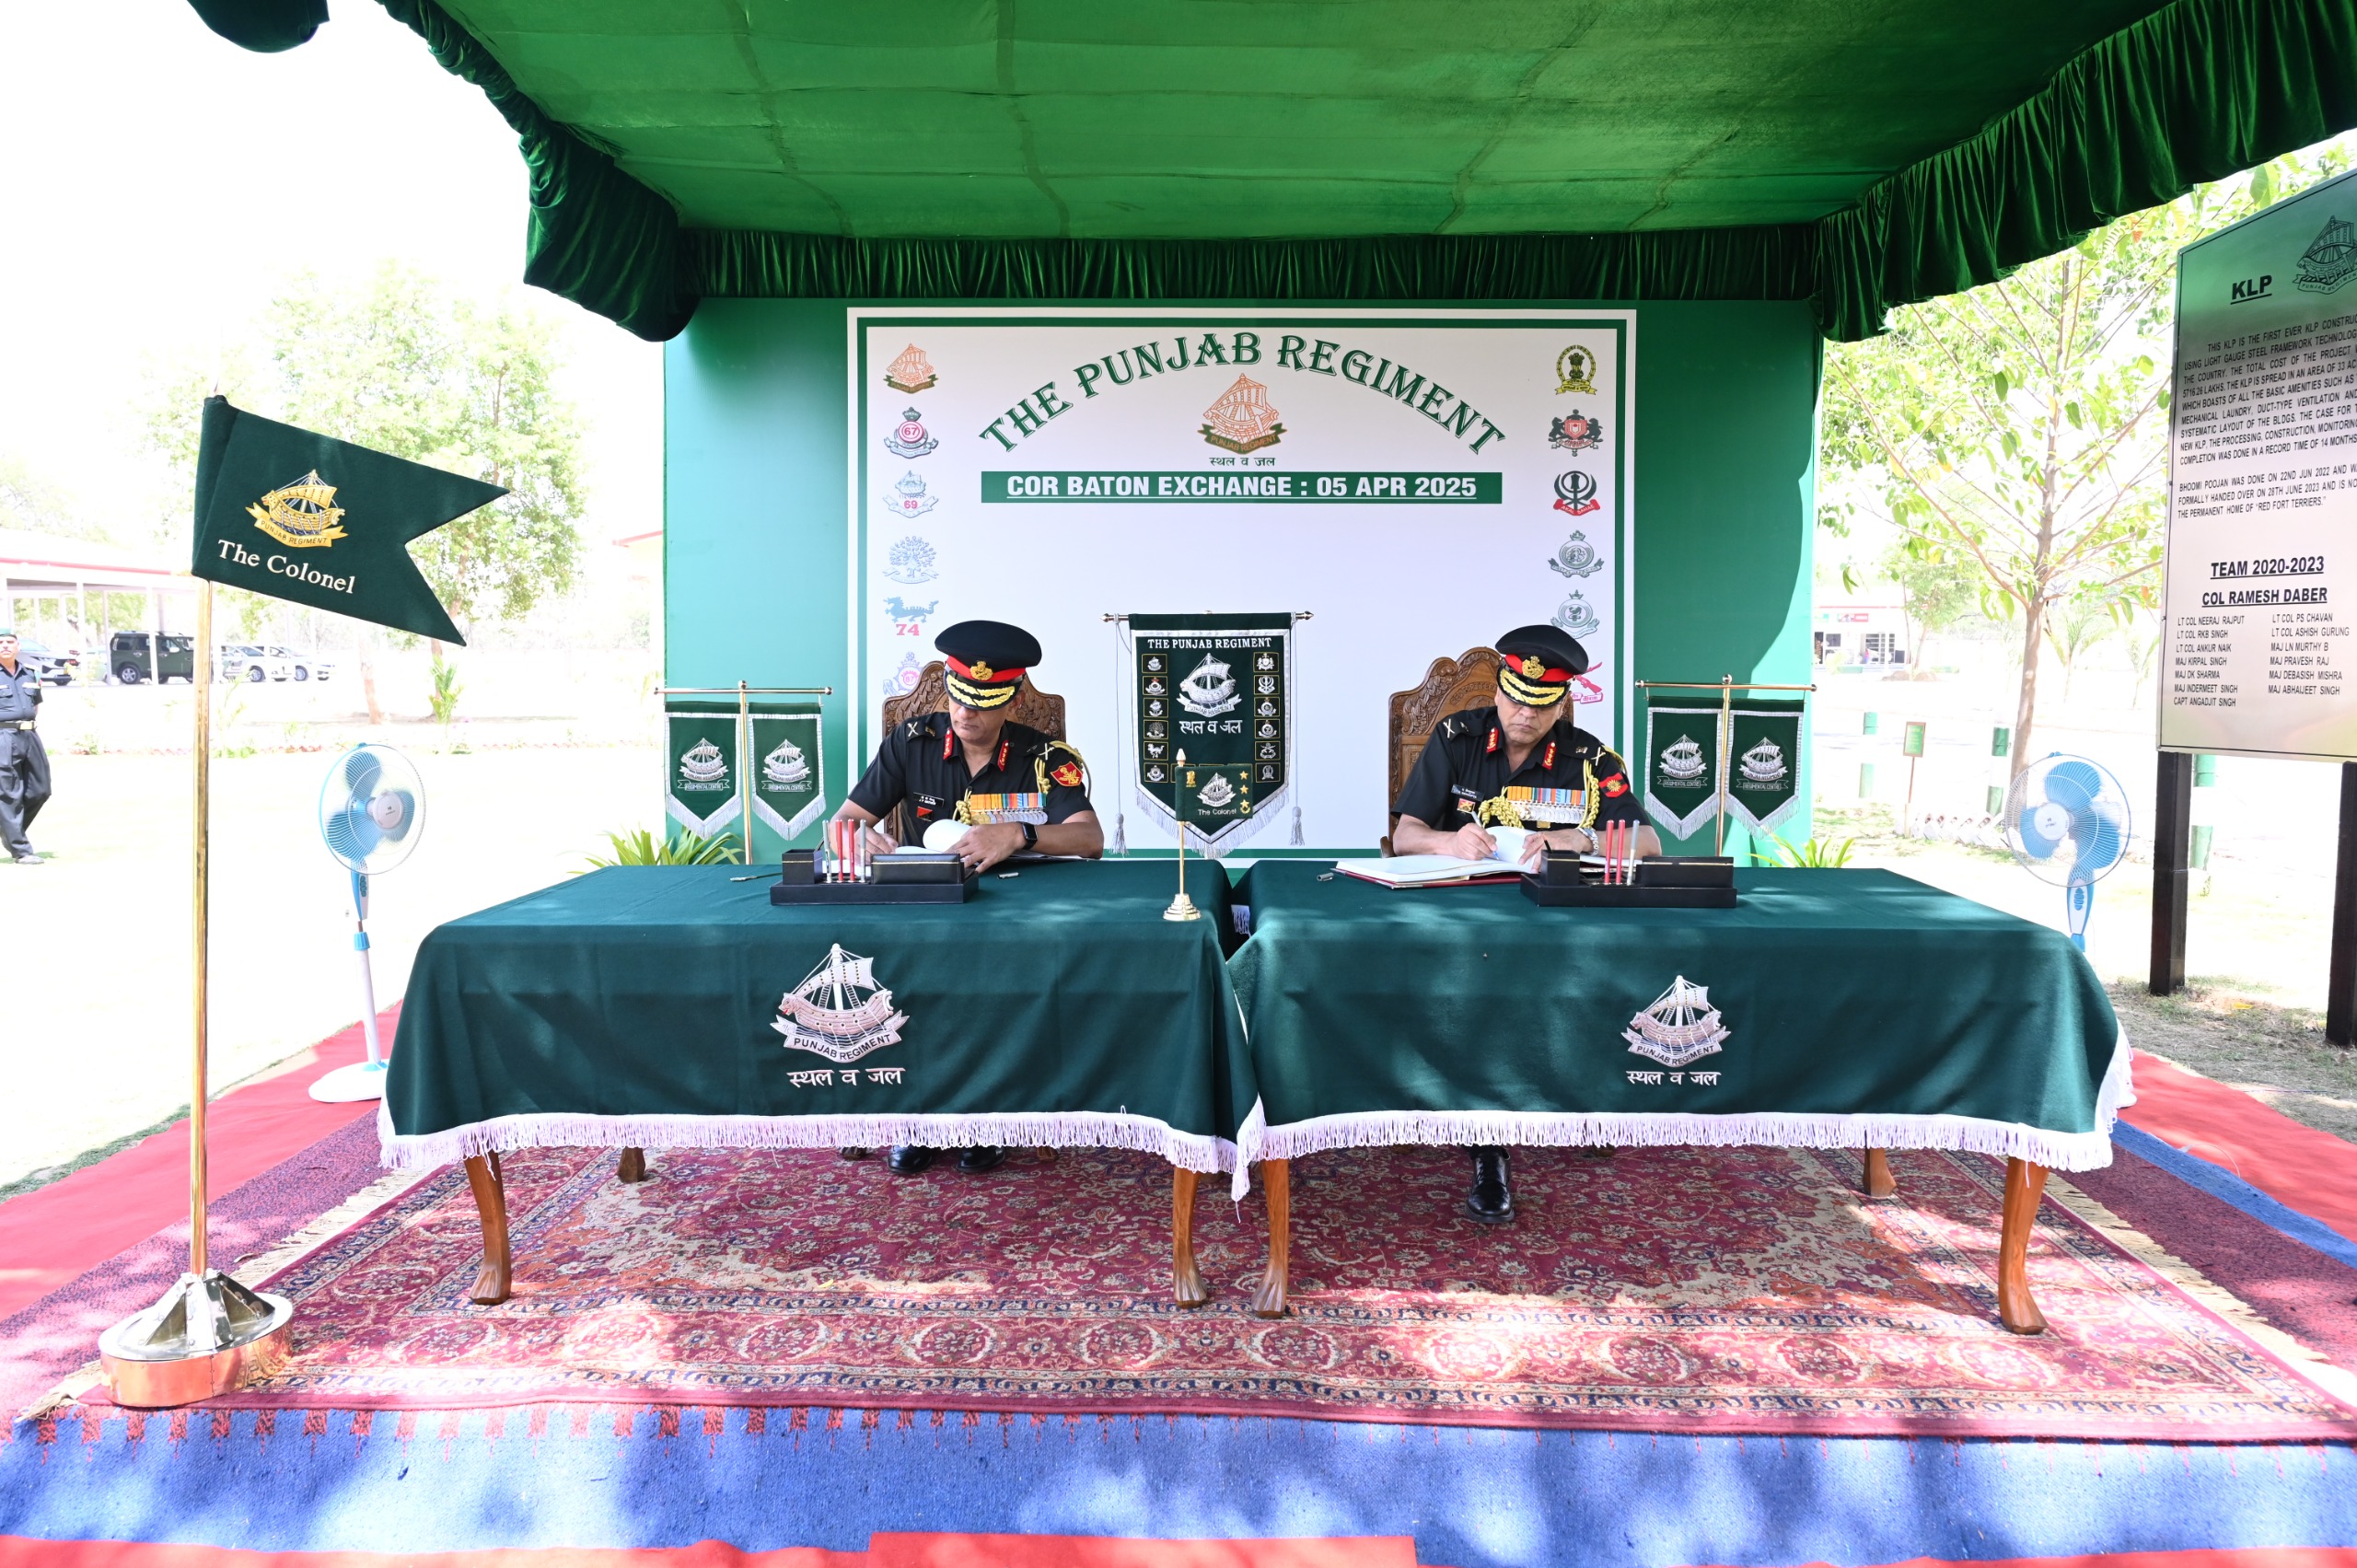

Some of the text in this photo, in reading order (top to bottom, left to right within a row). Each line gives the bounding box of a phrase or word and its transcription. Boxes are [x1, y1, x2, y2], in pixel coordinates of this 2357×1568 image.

[2232, 274, 2272, 300] KLP
[2185, 338, 2312, 370] USING LIGHT GAUGE STEEL FRAMEWORK
[978, 331, 1505, 455] THE PUNJAB REGIMENT
[2182, 375, 2354, 411] WHICH BOASTS OF ALL THE BASIC AMENITIES SUCH AS
[2181, 412, 2218, 424] MECHANICAL
[2258, 400, 2293, 413] DUCT-TYPE
[2298, 392, 2340, 406] VENTILATION
[2181, 425, 2217, 438] SYSTEMATIC
[2220, 421, 2244, 433] LAYOUT
[2247, 419, 2255, 428] OF
[2258, 417, 2270, 426] THE
[2300, 411, 2313, 421] THE
[2316, 408, 2334, 418] CASE
[2338, 405, 2351, 415] FOR
[904, 427, 918, 436] 67
[1211, 435, 1276, 451] PUNJAB REGIMENT
[2181, 442, 2192, 451] NEW
[2210, 438, 2220, 447] THE
[1209, 458, 1275, 466] स्थल व जल
[1007, 475, 1059, 496] COR
[1067, 476, 1149, 495] BATON
[1158, 476, 1291, 496] EXCHANGE
[1317, 477, 1347, 496] 05
[1355, 477, 1406, 496] APR
[1415, 477, 1477, 496] 2025
[2179, 465, 2347, 492] BHOOMI POOJAN WAS DONE ON 22ND JUN 2022 AND
[2178, 480, 2345, 505] FORMALLY HANDED OVER ON 28TH JUNE 2023 AND IS
[904, 500, 918, 509] 69
[2178, 509, 2189, 518] THE
[2190, 506, 2223, 517] PERMANENT
[2227, 504, 2243, 514] HOME
[2246, 504, 2253, 512] OF
[2273, 500, 2289, 509] FORT
[261, 521, 287, 541] PUNJAB
[218, 540, 355, 594] The Colonel
[2212, 556, 2324, 576] TEAM 2020-2023
[2202, 587, 2328, 605] COL RAMESH DABER
[2178, 616, 2245, 626] LT COL NEERAJ RAJPUT
[2272, 613, 2333, 622] LT COL PS CHAVAN
[895, 624, 919, 635] 74
[2177, 631, 2184, 639] LT
[2212, 630, 2228, 638] SINGH
[2272, 627, 2350, 636] LT COL ASHISH GURUNG
[1148, 637, 1271, 649] THE PUNJAB REGIMENT
[2177, 645, 2183, 653] LT
[2218, 644, 2232, 652] NAIK
[2271, 643, 2283, 651] MAJ
[2285, 643, 2293, 651] LN
[2295, 643, 2322, 651] MURTHY
[2270, 656, 2329, 666] MAJ PRAVESH RAJ
[2175, 670, 2220, 679] MAJ DK SHARMA
[2270, 670, 2342, 679] MAJ DEBASISH MISHRA
[2175, 684, 2185, 692] MAJ
[2269, 685, 2281, 693] MAJ
[2320, 686, 2340, 694] SINGH
[2174, 697, 2188, 705] CAPT
[2219, 698, 2235, 706] SINGH
[1207, 720, 1218, 734] व
[1220, 720, 1243, 733] जल
[794, 1034, 891, 1060] PUNJAB REGIMENT
[1637, 1045, 1714, 1065] PUNJAB REGIMENT
[786, 1067, 906, 1088] स्थल व जल
[1626, 1071, 1722, 1086] स्थल व जल
